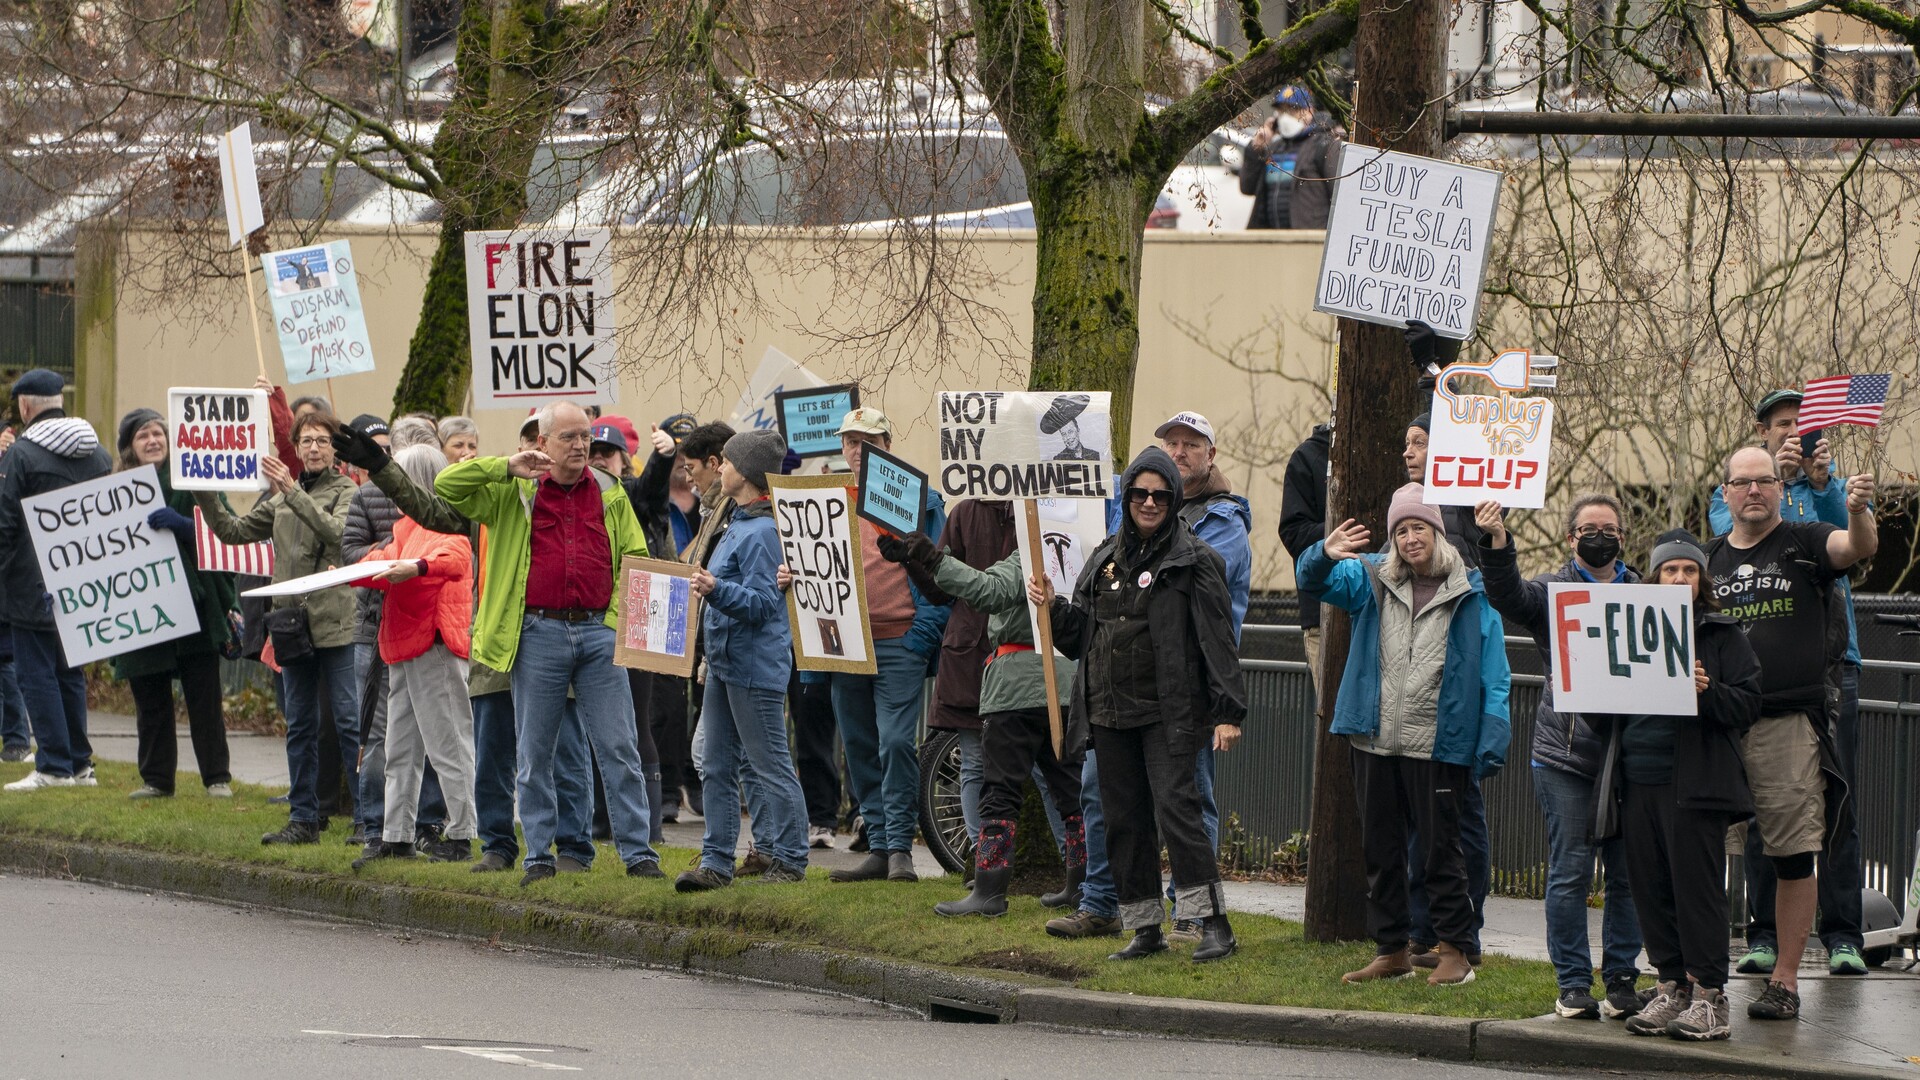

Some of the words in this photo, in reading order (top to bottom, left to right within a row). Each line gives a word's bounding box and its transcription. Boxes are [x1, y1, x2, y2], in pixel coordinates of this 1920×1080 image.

[1360, 159, 1428, 200] BUY
[1442, 176, 1464, 209] A
[1361, 198, 1472, 252] TESLA
[485, 240, 593, 289] FIRE
[1348, 235, 1435, 282] FUND
[1440, 255, 1462, 290] A
[291, 289, 350, 319] DISARM
[487, 291, 595, 339] ELON
[1325, 270, 1466, 329] DICTATOR
[297, 315, 346, 345] DEFUND
[491, 343, 596, 391] MUSK
[183, 395, 250, 423] STAND
[798, 401, 818, 413] LET'S
[820, 400, 835, 410] GET
[806, 415, 830, 426] LOUD!
[941, 392, 1004, 425] NOT
[1453, 392, 1546, 440] unplug
[177, 423, 257, 451] AGAINST
[792, 430, 823, 442] DEFUND
[940, 428, 986, 461] MY
[1488, 426, 1525, 456] the
[181, 453, 258, 480] FASCISM
[880, 464, 896, 481] LET'S
[897, 474, 909, 488] GET
[941, 463, 1107, 497] CROMWELL
[1432, 456, 1539, 490] COUP
[32, 478, 156, 532] DEFUND
[869, 491, 894, 512] DEFUND
[894, 504, 914, 523] MUSK
[883, 482, 903, 500] LOUD!
[777, 498, 845, 541] STOP
[48, 521, 151, 572] MUSK
[785, 540, 850, 581] ELON
[57, 556, 176, 615] BOYCOTT
[631, 577, 652, 594] GET
[794, 579, 851, 616] COUP
[1735, 593, 1755, 604] THE
[1756, 576, 1772, 589] IS
[1774, 578, 1792, 592] IN
[669, 603, 684, 620] UP
[1721, 597, 1794, 618] RDWARE
[77, 603, 177, 648] TESLA
[629, 623, 648, 642] YOUR
[1556, 590, 1691, 692] F-ELON
